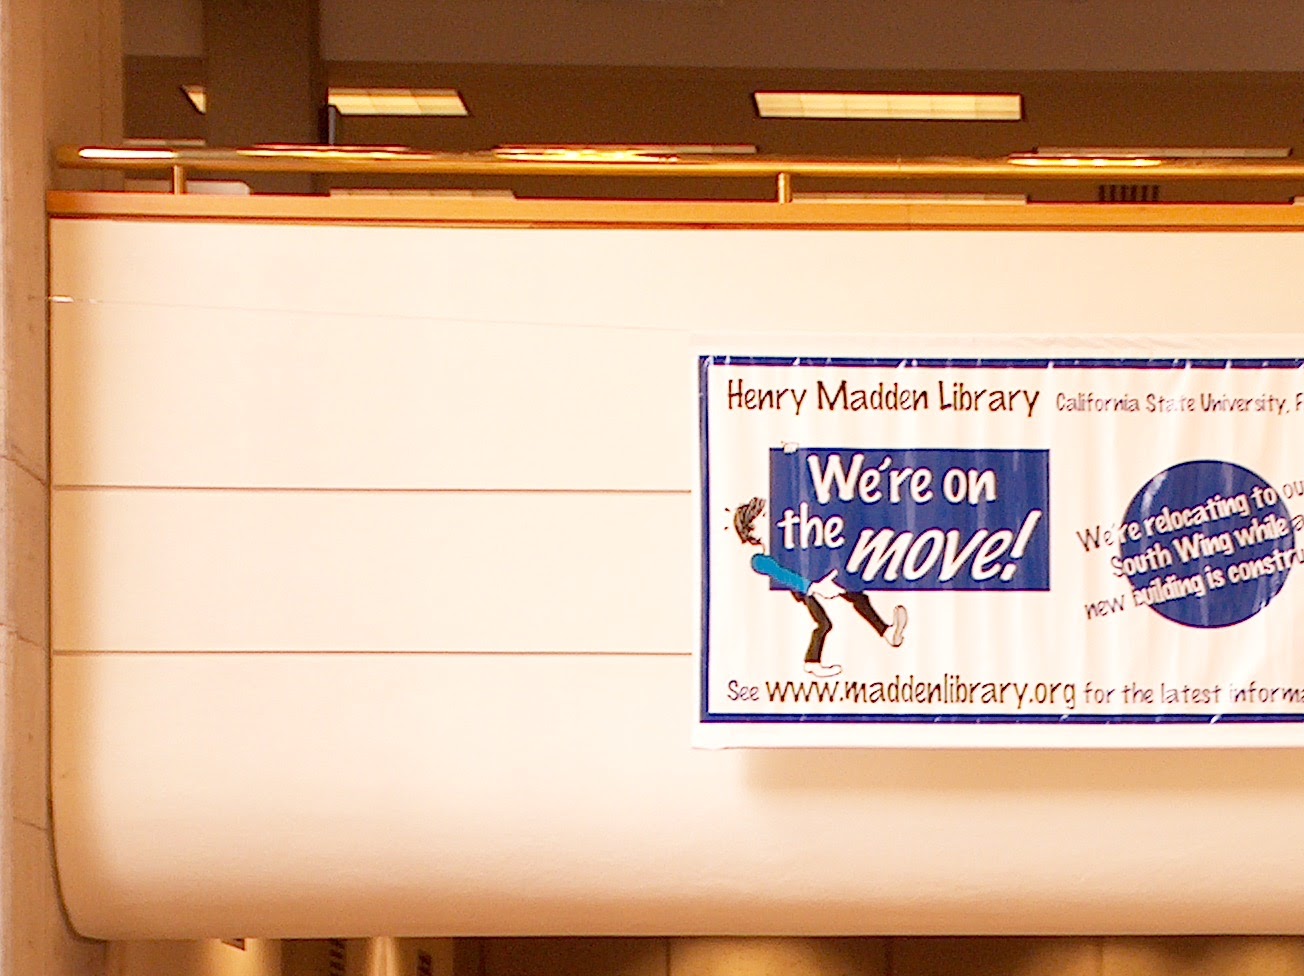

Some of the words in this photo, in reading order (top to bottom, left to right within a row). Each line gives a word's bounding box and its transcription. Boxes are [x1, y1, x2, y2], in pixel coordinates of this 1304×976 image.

[727, 378, 807, 415] Henry
[817, 380, 929, 411] Madden
[938, 380, 1040, 417] Library
[1056, 392, 1139, 412] California
[1146, 393, 1195, 412] State
[1200, 392, 1290, 415] University,
[807, 453, 934, 504] We're
[943, 467, 998, 505] on
[776, 502, 846, 550] the
[846, 508, 1043, 582] move!
[1076, 520, 1142, 552] We're
[1144, 492, 1249, 537] relocating
[1251, 486, 1277, 509] to
[1111, 545, 1173, 578] South
[1174, 531, 1235, 564] Wing
[1232, 512, 1290, 548] while
[1084, 594, 1125, 620] new
[1131, 571, 1206, 606] building
[1206, 565, 1225, 590] is
[727, 679, 760, 701] See
[765, 673, 1076, 710] www.maddenlibrary.org
[1084, 681, 1115, 703] for
[1121, 682, 1153, 704] the
[1160, 683, 1222, 704] latest
